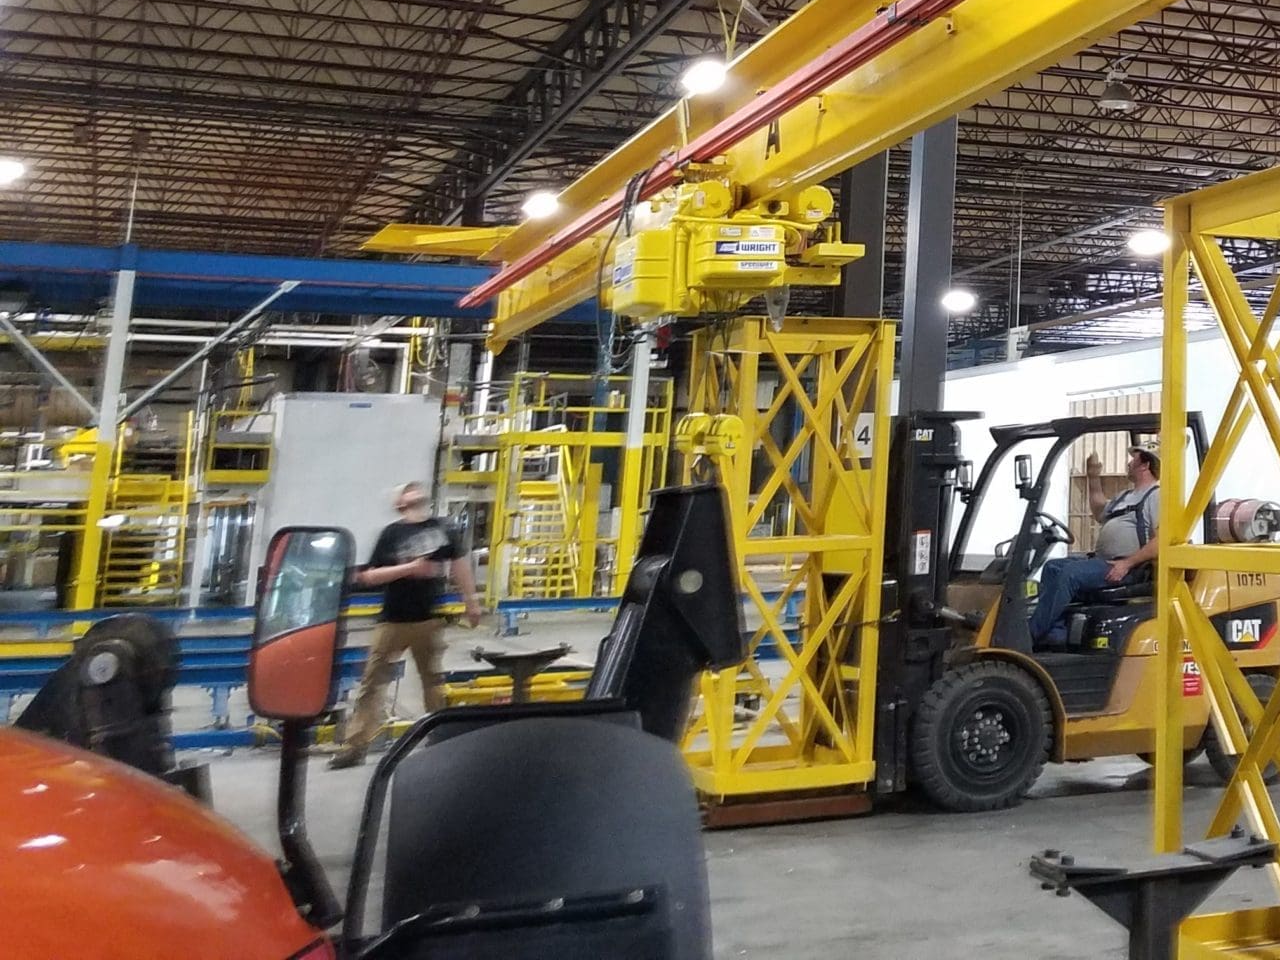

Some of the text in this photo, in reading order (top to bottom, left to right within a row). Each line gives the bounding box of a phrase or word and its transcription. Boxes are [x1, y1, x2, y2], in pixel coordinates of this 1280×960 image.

[741, 243, 776, 252] WRIGHT
[915, 428, 935, 441] CAT
[1231, 619, 1262, 643] CAT
